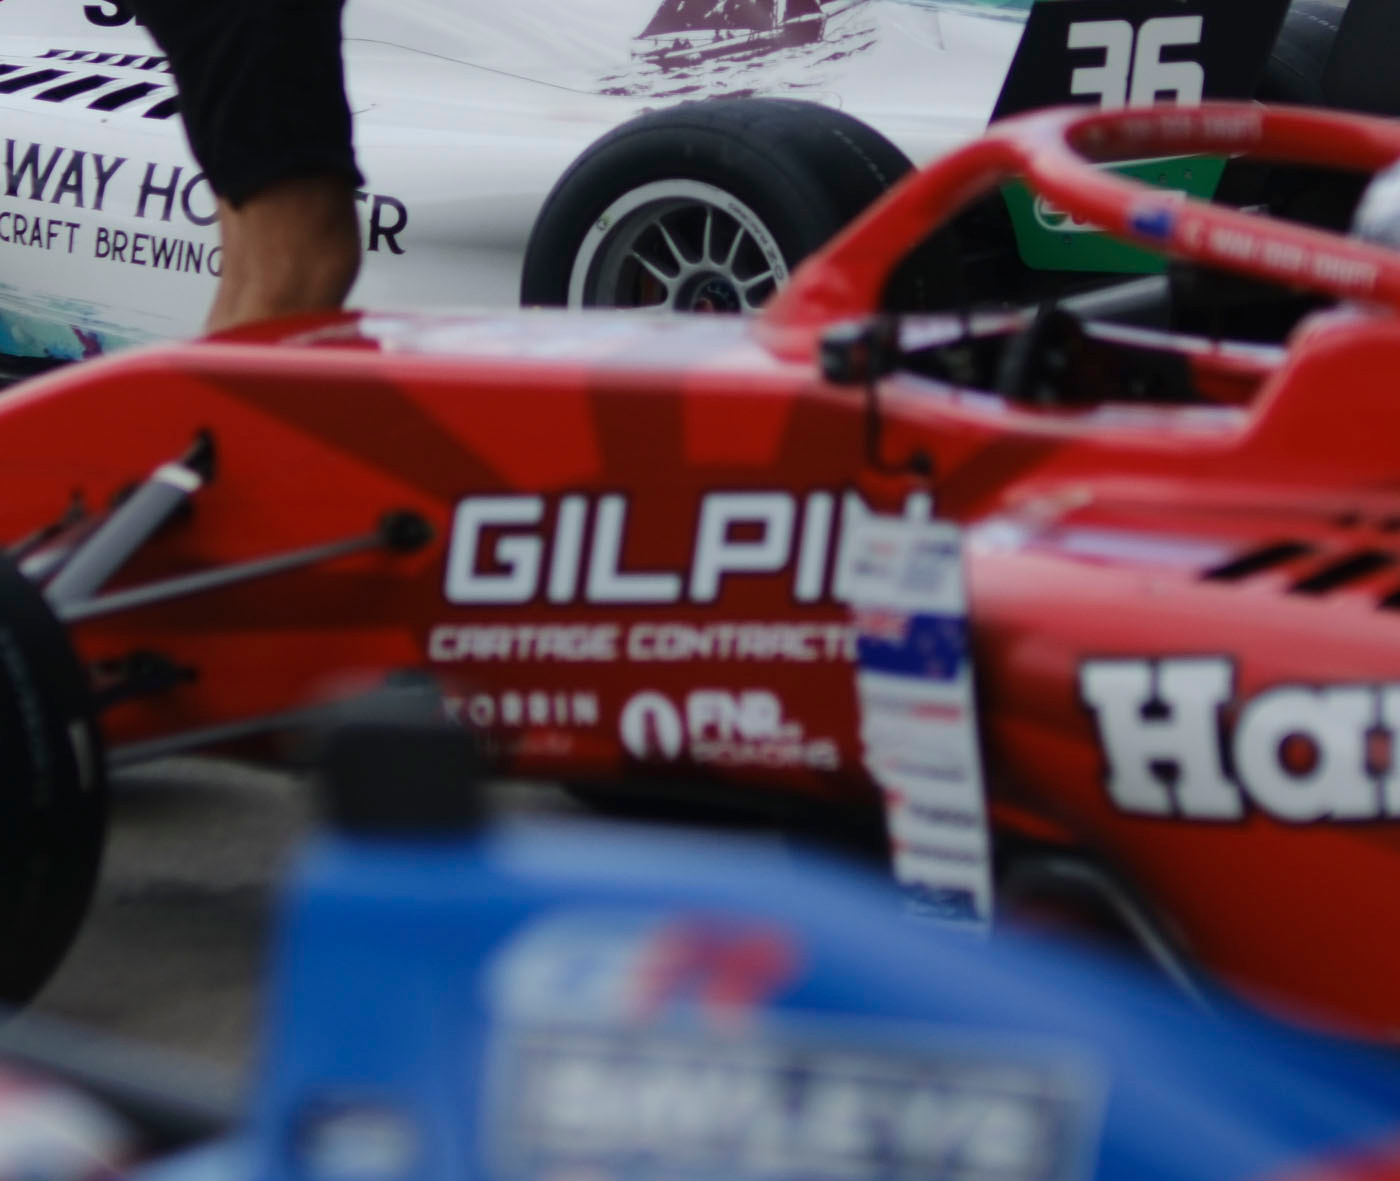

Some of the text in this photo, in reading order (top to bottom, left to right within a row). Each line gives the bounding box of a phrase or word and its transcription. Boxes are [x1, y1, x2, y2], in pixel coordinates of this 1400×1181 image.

[1067, 14, 1205, 106] 36
[95, 227, 222, 277] BREWING
[138, 160, 408, 256] HOR
[445, 492, 931, 604] GILPI
[429, 624, 856, 661] CARTAGE CONTRACT
